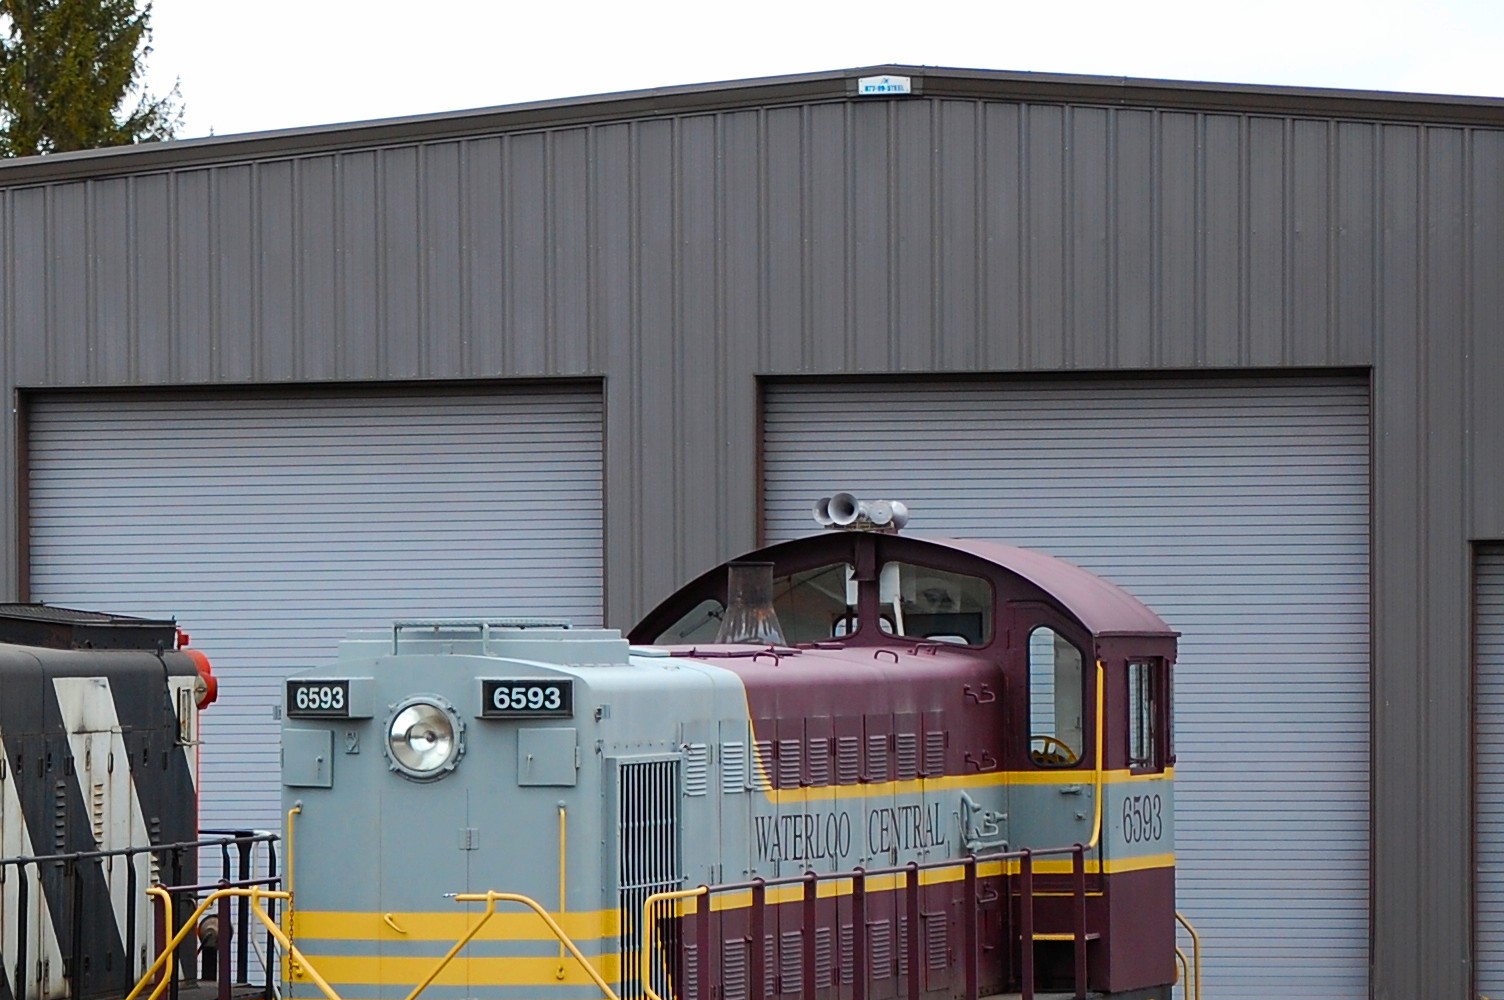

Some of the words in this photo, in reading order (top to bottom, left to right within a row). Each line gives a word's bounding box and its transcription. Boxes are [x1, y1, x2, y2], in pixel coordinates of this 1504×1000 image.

[296, 686, 344, 710] 6593
[493, 686, 561, 710] 6593
[754, 811, 851, 862] WATERLOO
[869, 803, 945, 856] CENTRAL
[1123, 794, 1162, 843] 6593
